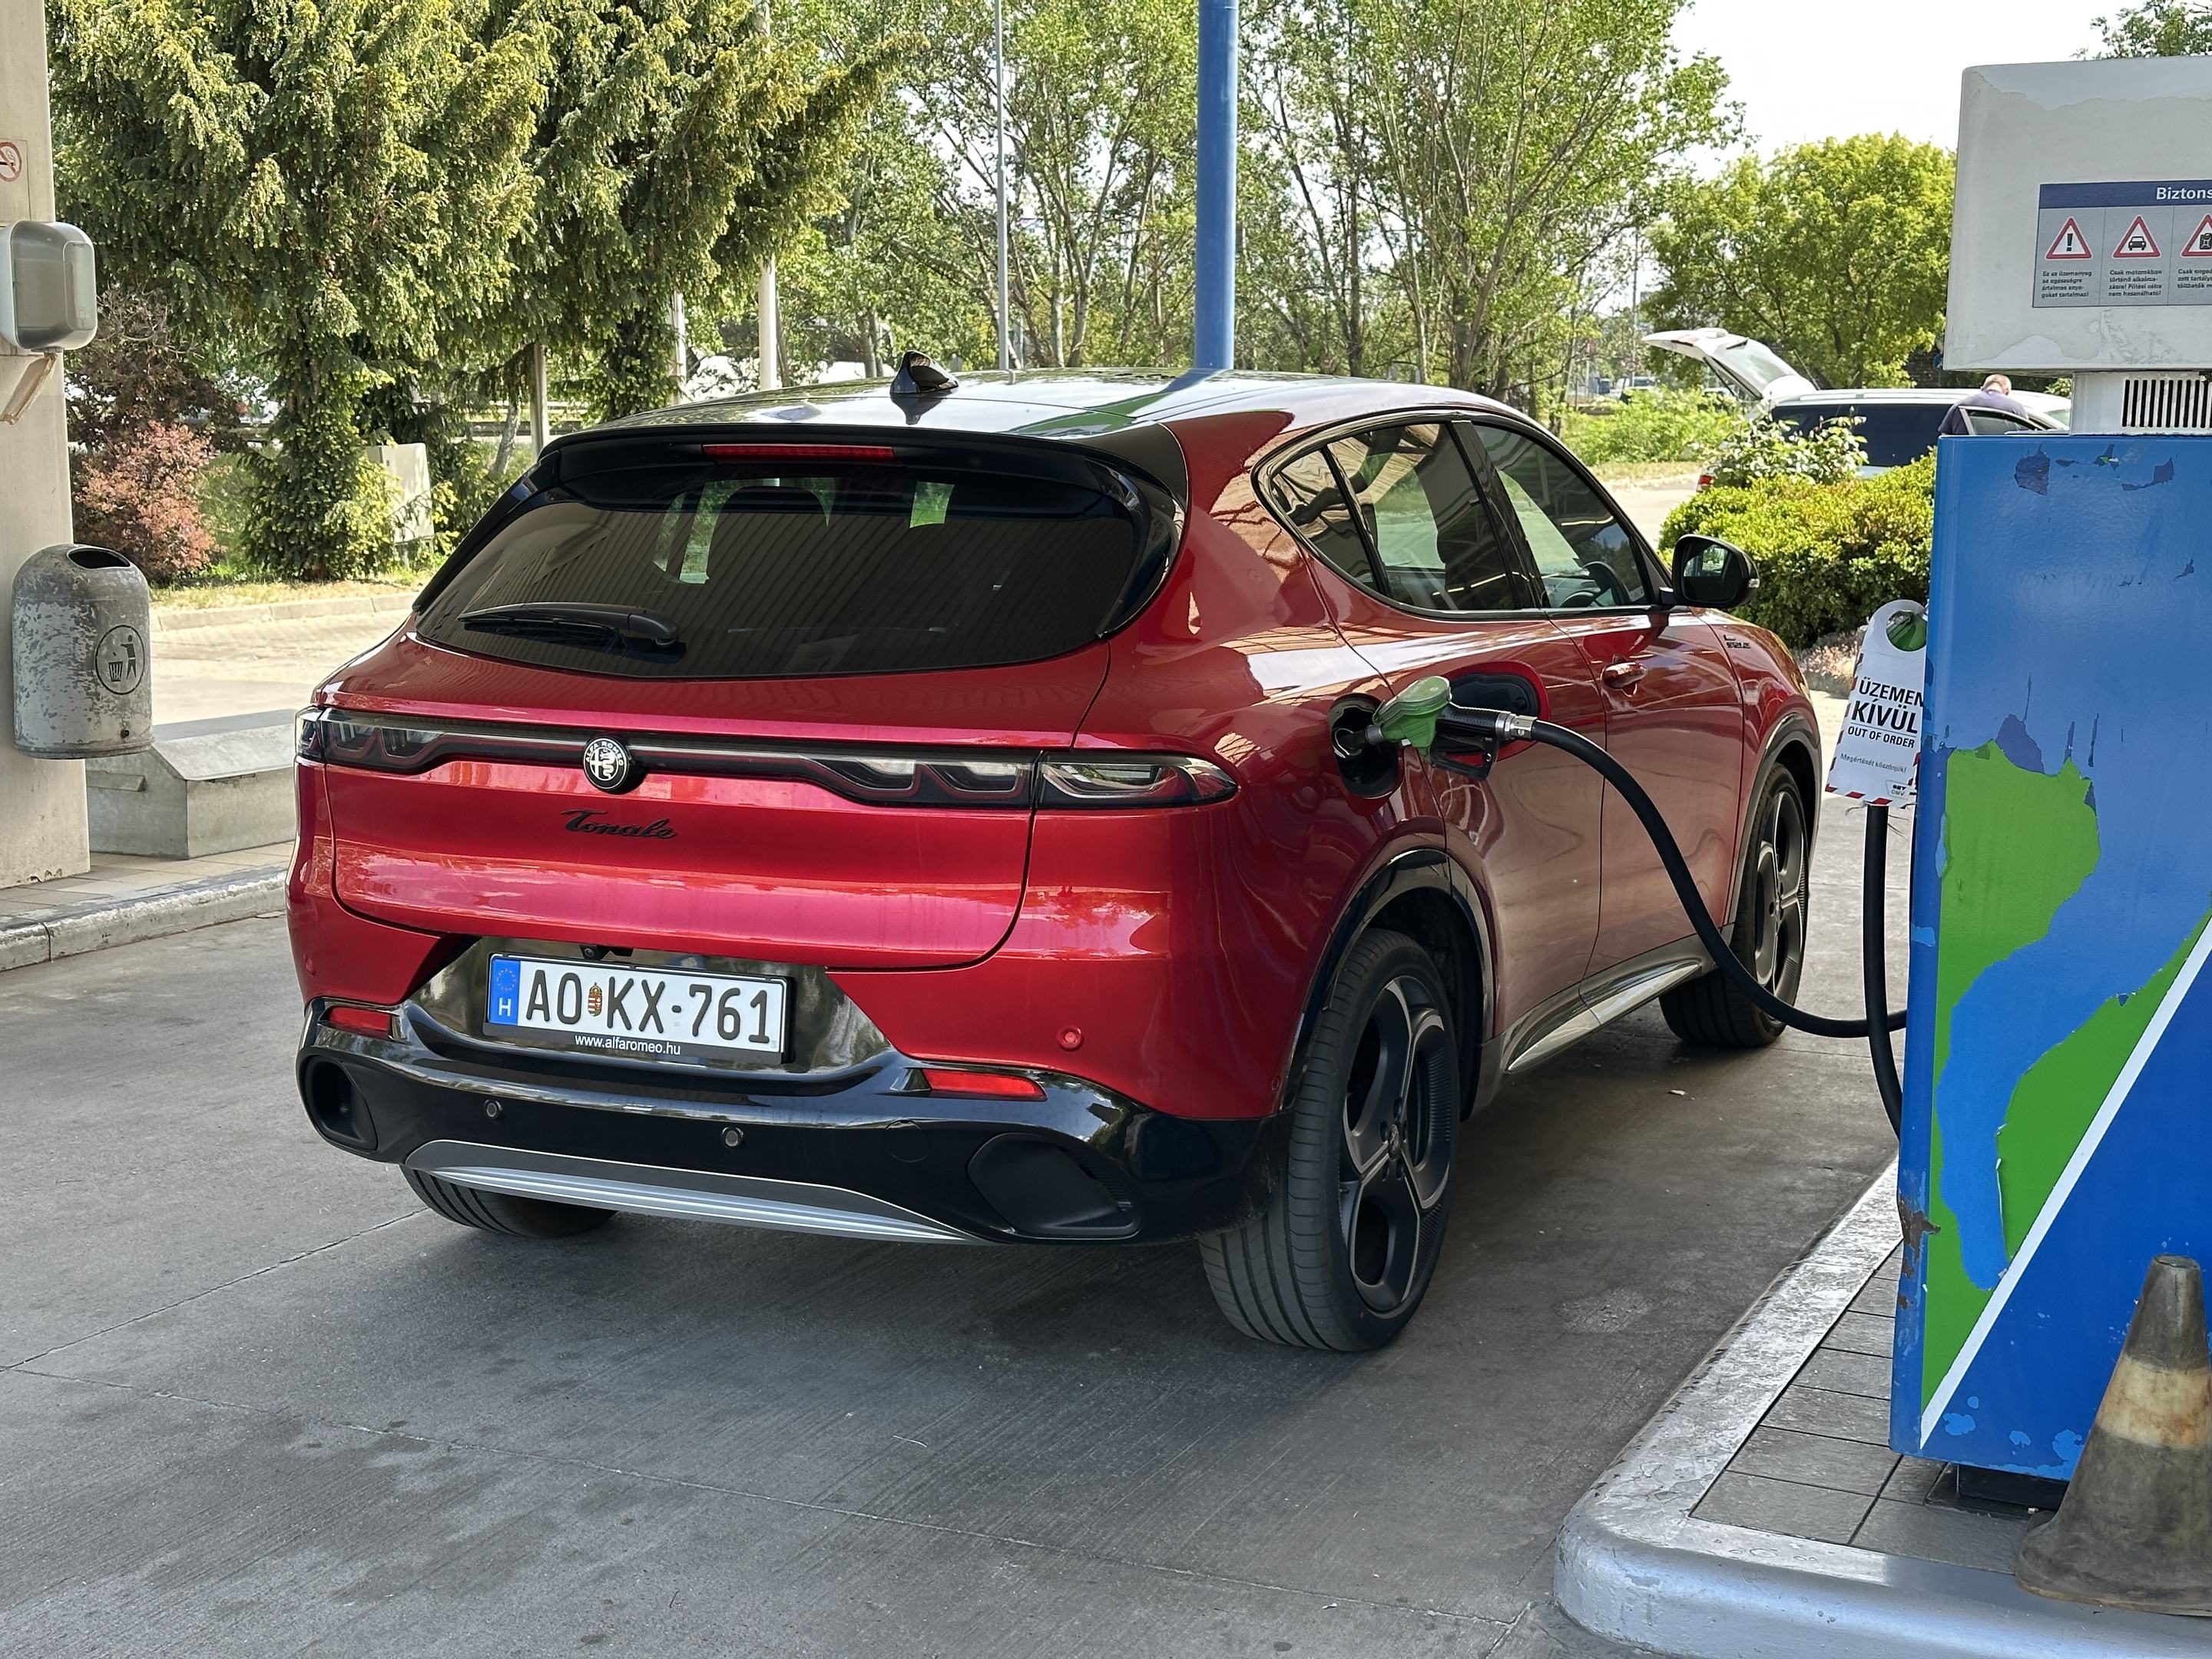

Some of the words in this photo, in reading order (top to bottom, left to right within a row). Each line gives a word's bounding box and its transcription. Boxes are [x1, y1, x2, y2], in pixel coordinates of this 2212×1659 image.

[2156, 187, 2212, 200] Biztons
[1859, 676, 1924, 707] ÜZEMEN
[1851, 698, 1918, 734] KÍVÜL
[1847, 726, 1868, 737] OUT
[1869, 730, 1882, 740] OF
[1883, 733, 1916, 749] ORDER
[601, 741, 624, 767] ROMEO
[560, 808, 677, 839] Tonale
[498, 997, 512, 1018] H
[574, 1035, 681, 1055] www.alfaromeo.hu
